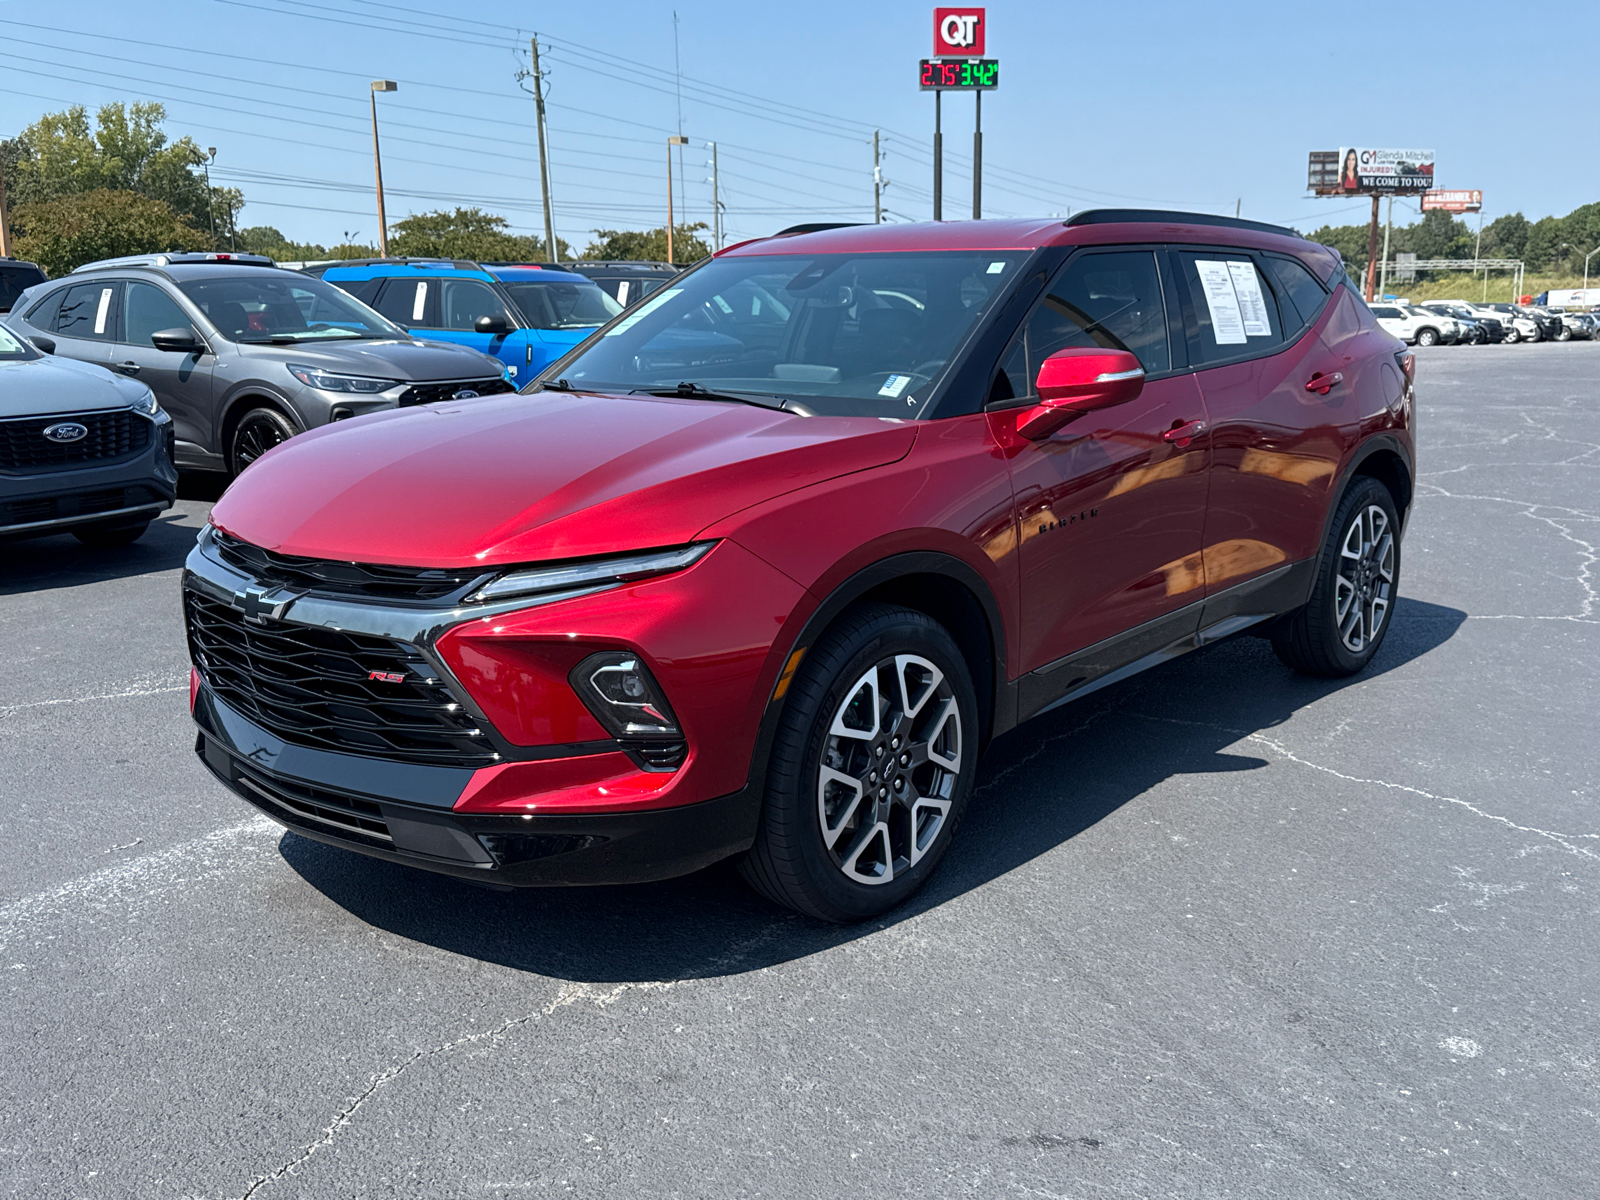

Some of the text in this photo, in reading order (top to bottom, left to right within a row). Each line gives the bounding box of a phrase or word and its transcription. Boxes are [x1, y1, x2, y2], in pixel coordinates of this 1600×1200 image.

[940, 14, 979, 47] QT
[1377, 150, 1434, 161] Glenda Mitchell
[1361, 166, 1394, 174] INJURED?
[1362, 177, 1432, 187] WE COME TO YOU!
[56, 427, 79, 439] Ford
[369, 671, 405, 684] RS
